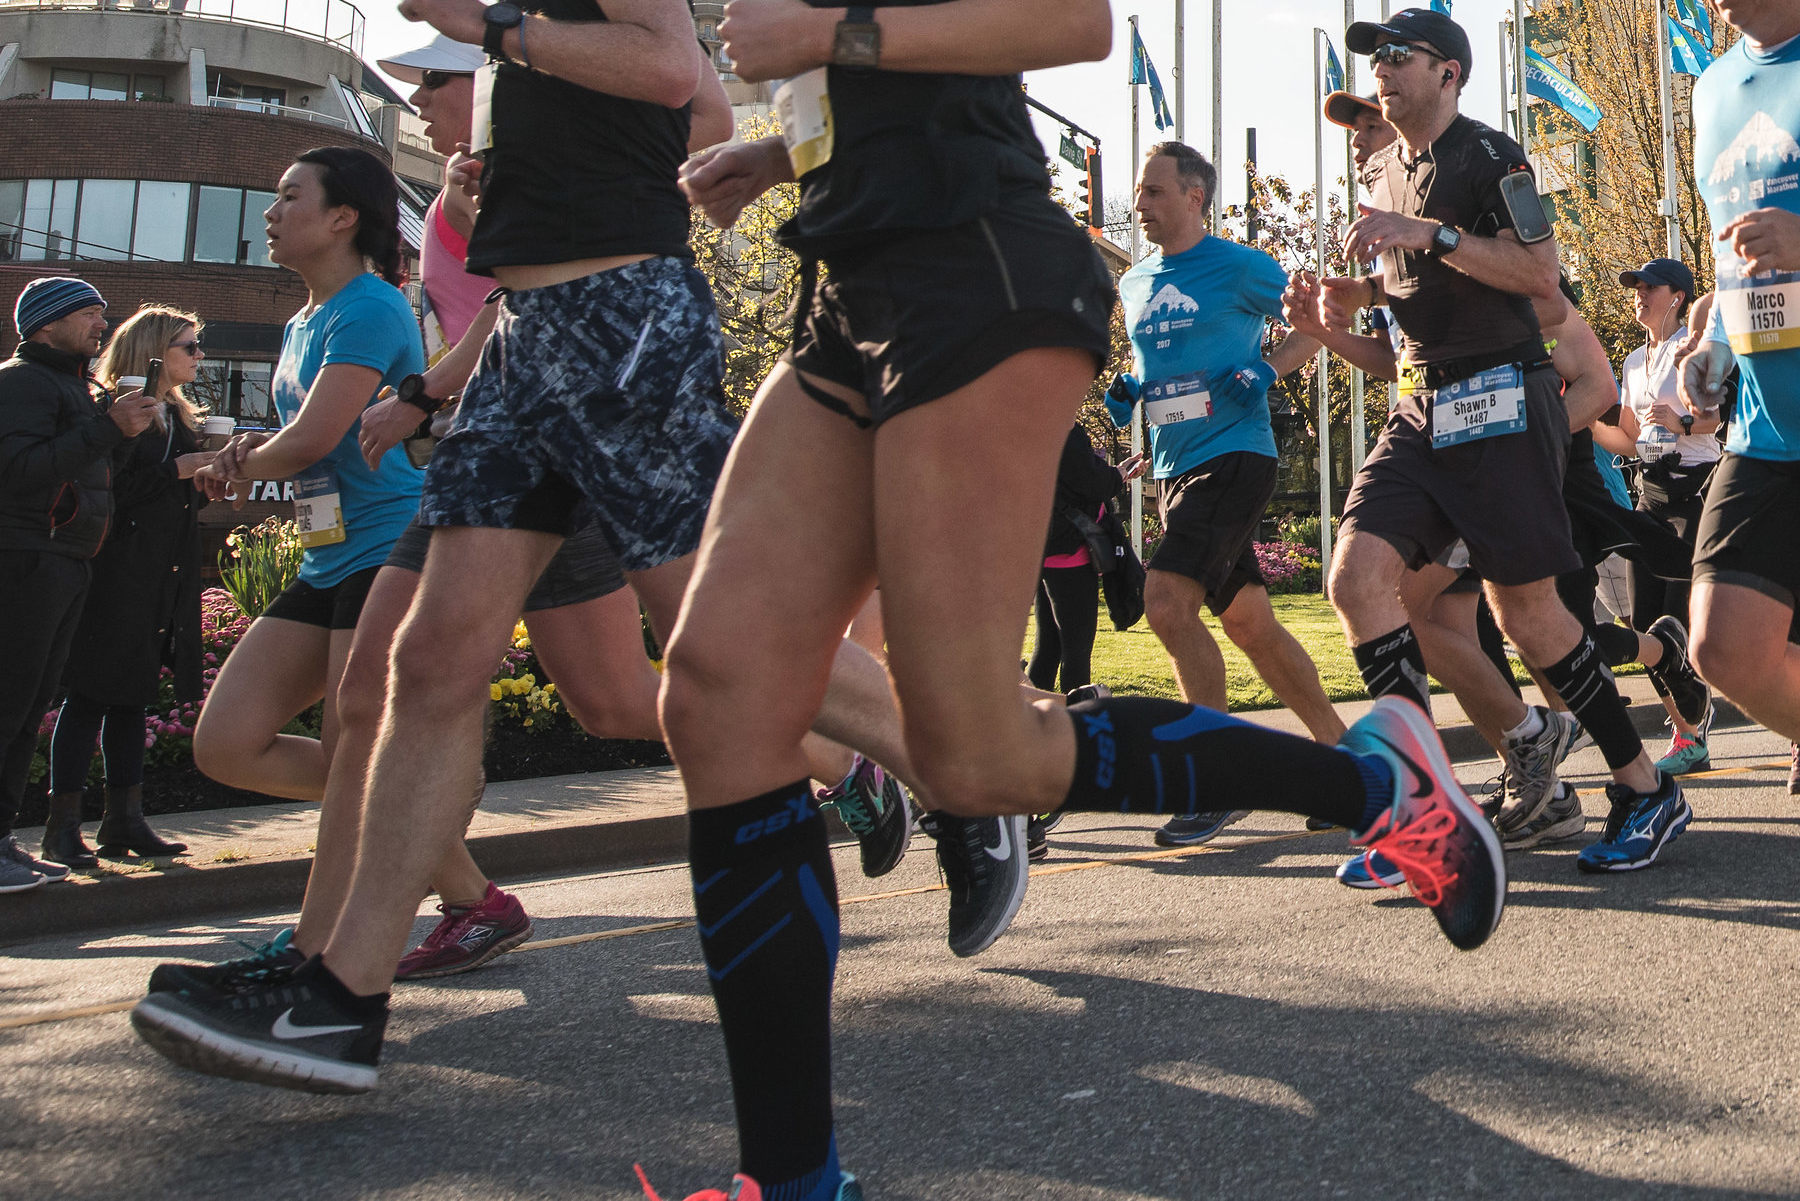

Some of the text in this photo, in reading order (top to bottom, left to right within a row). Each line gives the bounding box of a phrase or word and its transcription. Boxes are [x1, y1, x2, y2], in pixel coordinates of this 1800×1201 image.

[1525, 65, 1585, 108] PECTACULAR!
[1061, 139, 1083, 166] Davie St
[1480, 138, 1500, 160] 2XU
[1766, 173, 1799, 186] Vancouver
[1767, 182, 1799, 195] Marathon
[1747, 291, 1785, 310] Marco
[1751, 311, 1785, 330] 11570
[1156, 339, 1171, 350] 2017
[1759, 332, 1779, 345] 11570
[1484, 372, 1514, 381] Vancouver
[1484, 378, 1512, 386] Marathon
[1454, 393, 1497, 416] Shawn B
[1165, 410, 1185, 423] 17515
[1463, 411, 1489, 427] 14487
[1469, 426, 1485, 436] 14487
